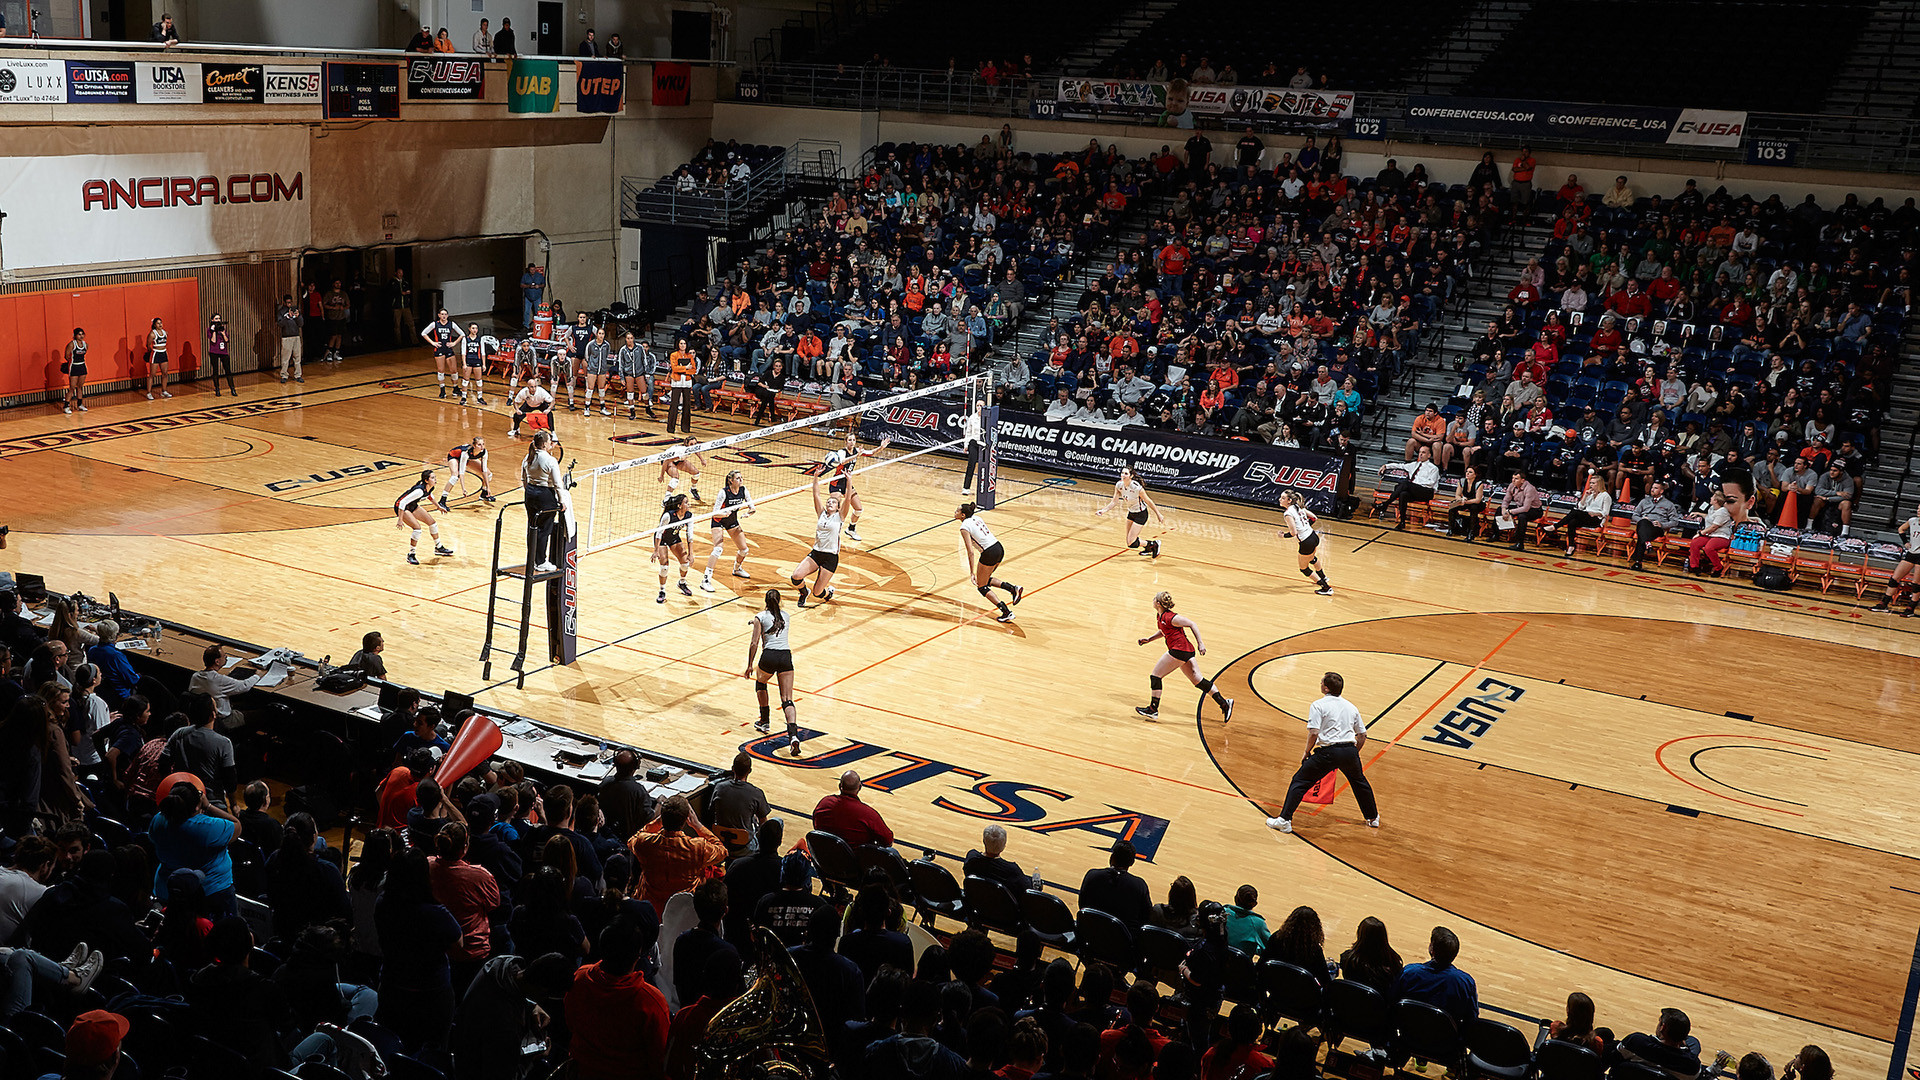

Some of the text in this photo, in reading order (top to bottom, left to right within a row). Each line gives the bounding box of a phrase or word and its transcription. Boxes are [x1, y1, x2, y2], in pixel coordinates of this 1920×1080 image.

[73, 69, 129, 82] GoUTSA.com
[152, 67, 185, 83] UTSA
[206, 67, 256, 87] Comet
[657, 75, 686, 91] WKU
[515, 75, 552, 97] UAB
[580, 77, 622, 96] UTEP
[740, 88, 758, 98] 100
[1036, 104, 1055, 115] 101
[1410, 107, 1667, 130] CONFERENCEUSA.COM @CONFERENCE_USA
[1355, 123, 1379, 135] 102
[1757, 147, 1787, 160] 103
[82, 171, 303, 211] ANCIRA.COM
[947, 413, 1240, 470] COERENCE USA CHAMPIONSHIP
[1064, 449, 1127, 467] @Conference_USA
[1134, 461, 1180, 476] #CUSAChamp
[1476, 550, 1863, 618] goUTSA.com
[738, 726, 1171, 865] UTSA
